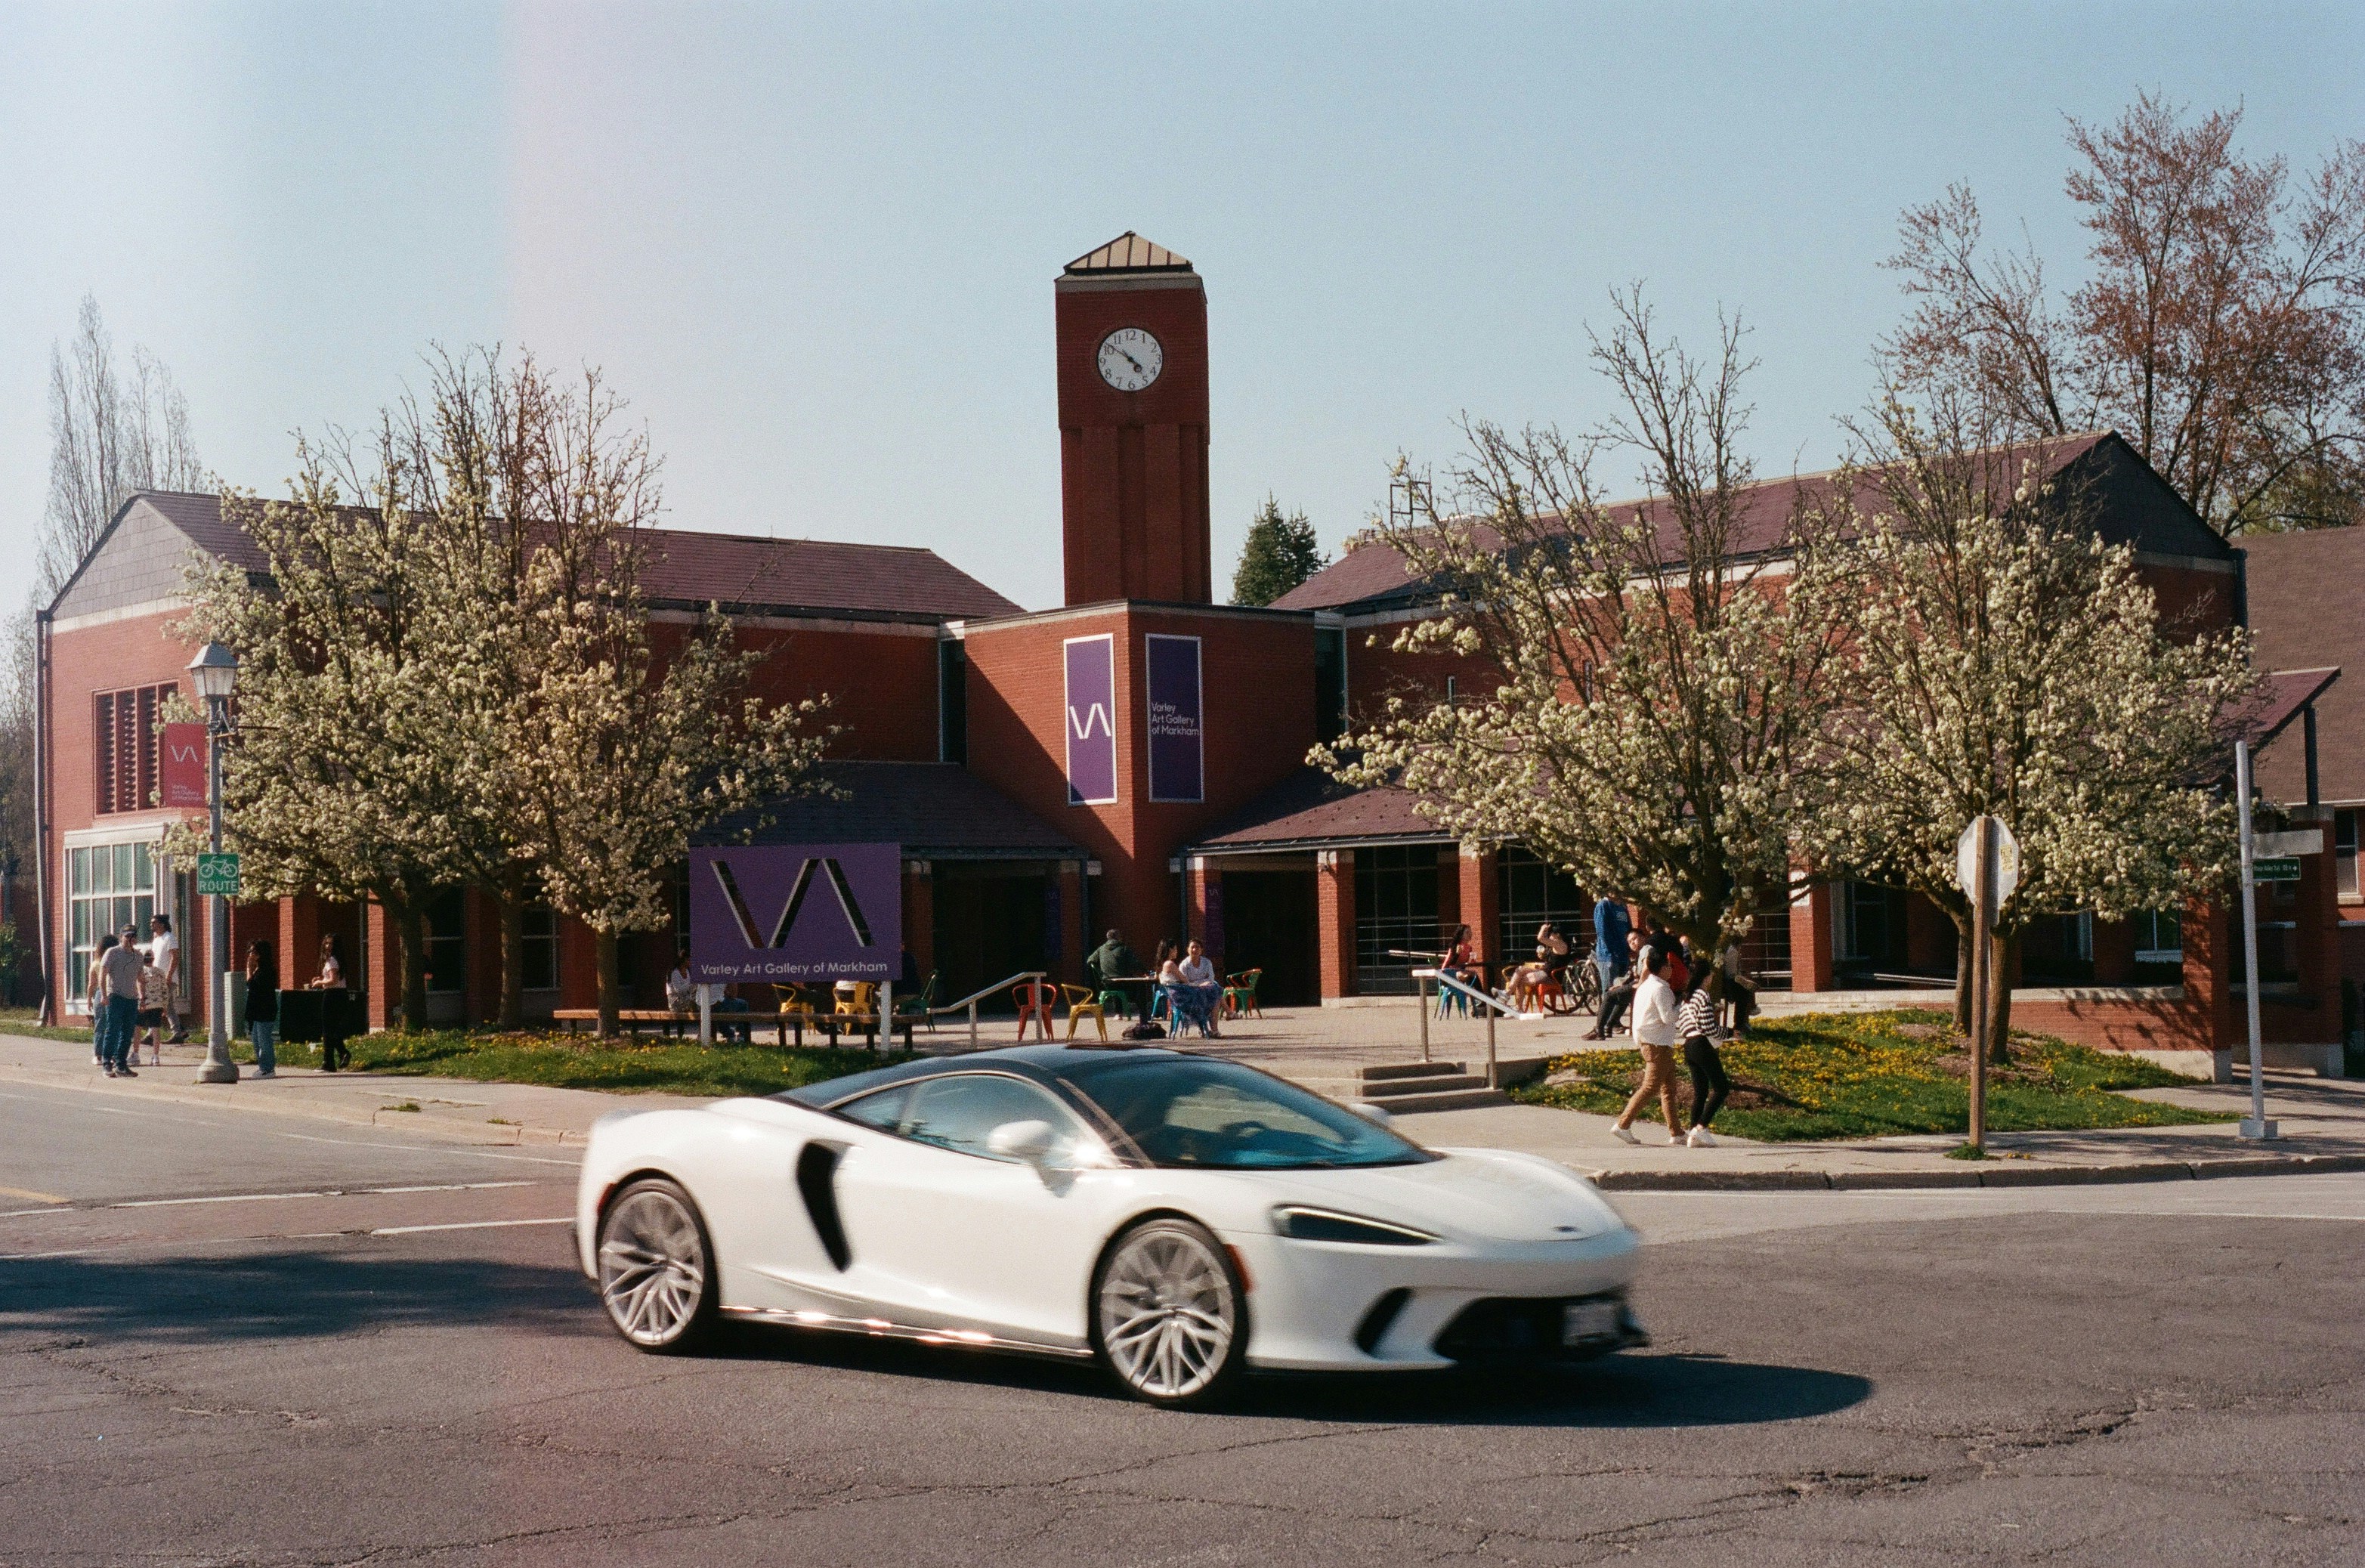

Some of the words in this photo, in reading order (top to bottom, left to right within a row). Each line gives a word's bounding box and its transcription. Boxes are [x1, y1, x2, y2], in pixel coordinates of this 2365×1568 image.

[1113, 334, 1122, 345] 11
[1124, 330, 1136, 341] 12
[1141, 333, 1146, 343] 1
[1103, 345, 1114, 355] 10
[1151, 343, 1157, 353] 2
[1099, 357, 1106, 367] 9
[1155, 354, 1162, 364] 3
[1105, 368, 1112, 379] 8
[1149, 367, 1157, 376] 4
[1116, 377, 1124, 388] 7
[1128, 380, 1136, 390] 6
[1142, 376, 1148, 386] 5
[1151, 702, 1176, 714] Varley
[1151, 714, 1165, 724] Art
[1166, 714, 1195, 727] Gallery
[1152, 726, 1161, 735] of
[1161, 726, 1200, 736] Markham
[199, 880, 238, 892] ROUTE
[701, 964, 740, 978] Varley
[744, 963, 762, 974] Art
[765, 962, 810, 976] Gallery
[813, 962, 824, 973] of
[827, 961, 888, 973] Markham
